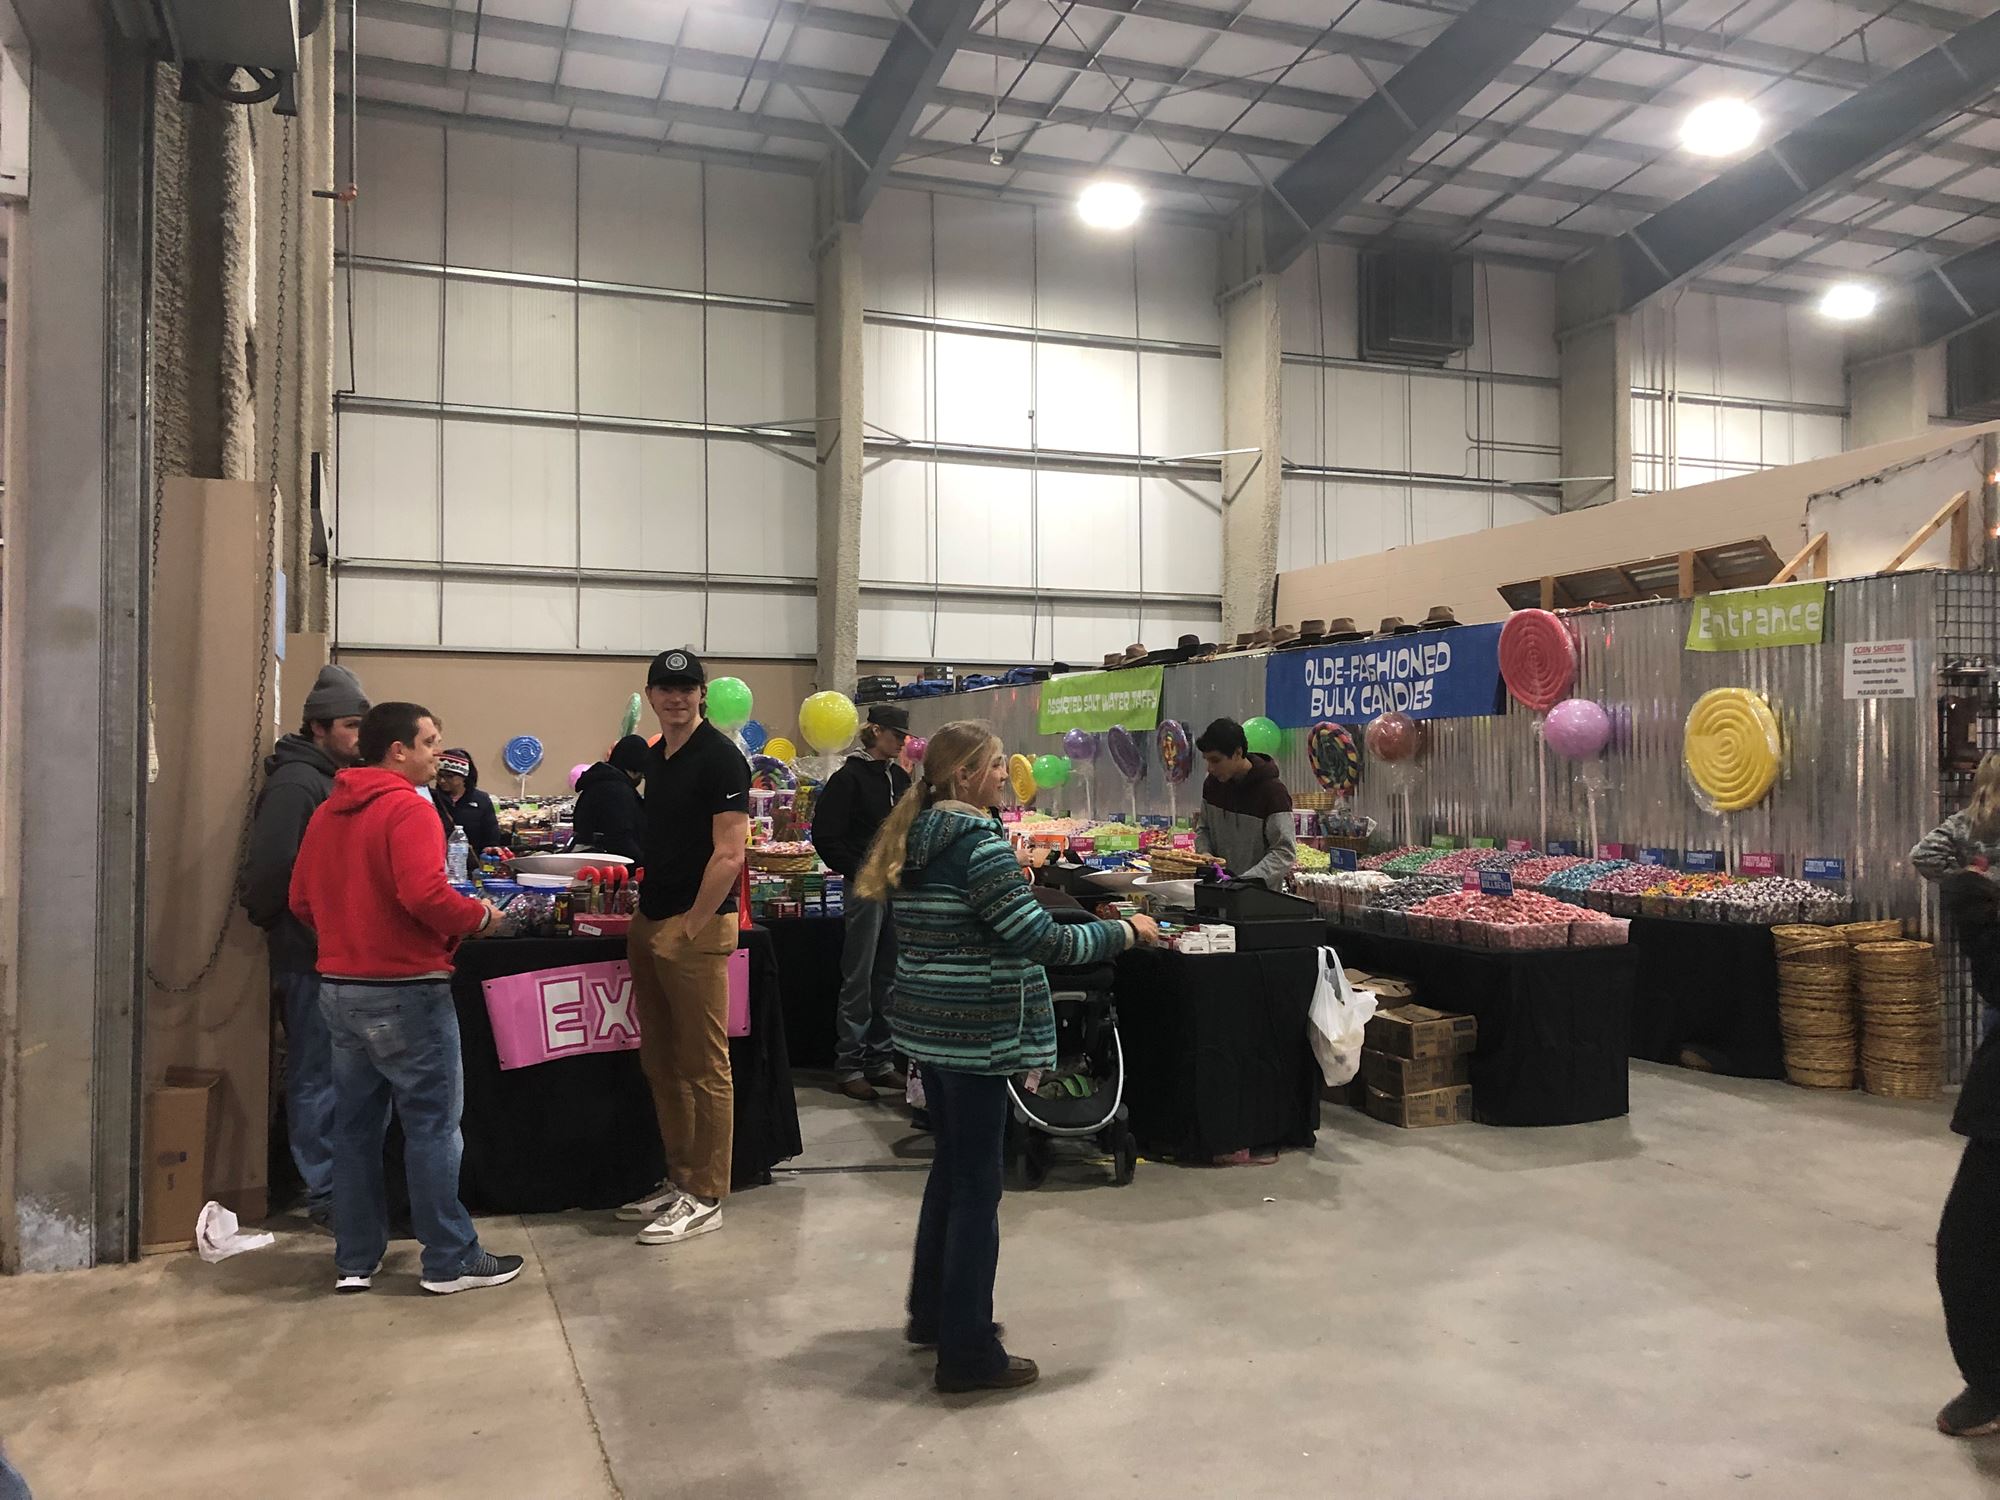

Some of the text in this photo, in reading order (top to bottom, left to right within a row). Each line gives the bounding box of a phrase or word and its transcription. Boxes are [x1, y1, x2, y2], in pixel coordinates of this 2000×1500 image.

[1699, 602, 1821, 639] Entrance
[1305, 641, 1452, 687] OLDE-FASHIONED
[1047, 689, 1157, 716] ASSORTED SALT WATER TAFFY
[1310, 677, 1434, 718] BULK CANDIES
[538, 974, 641, 1054] Ex
